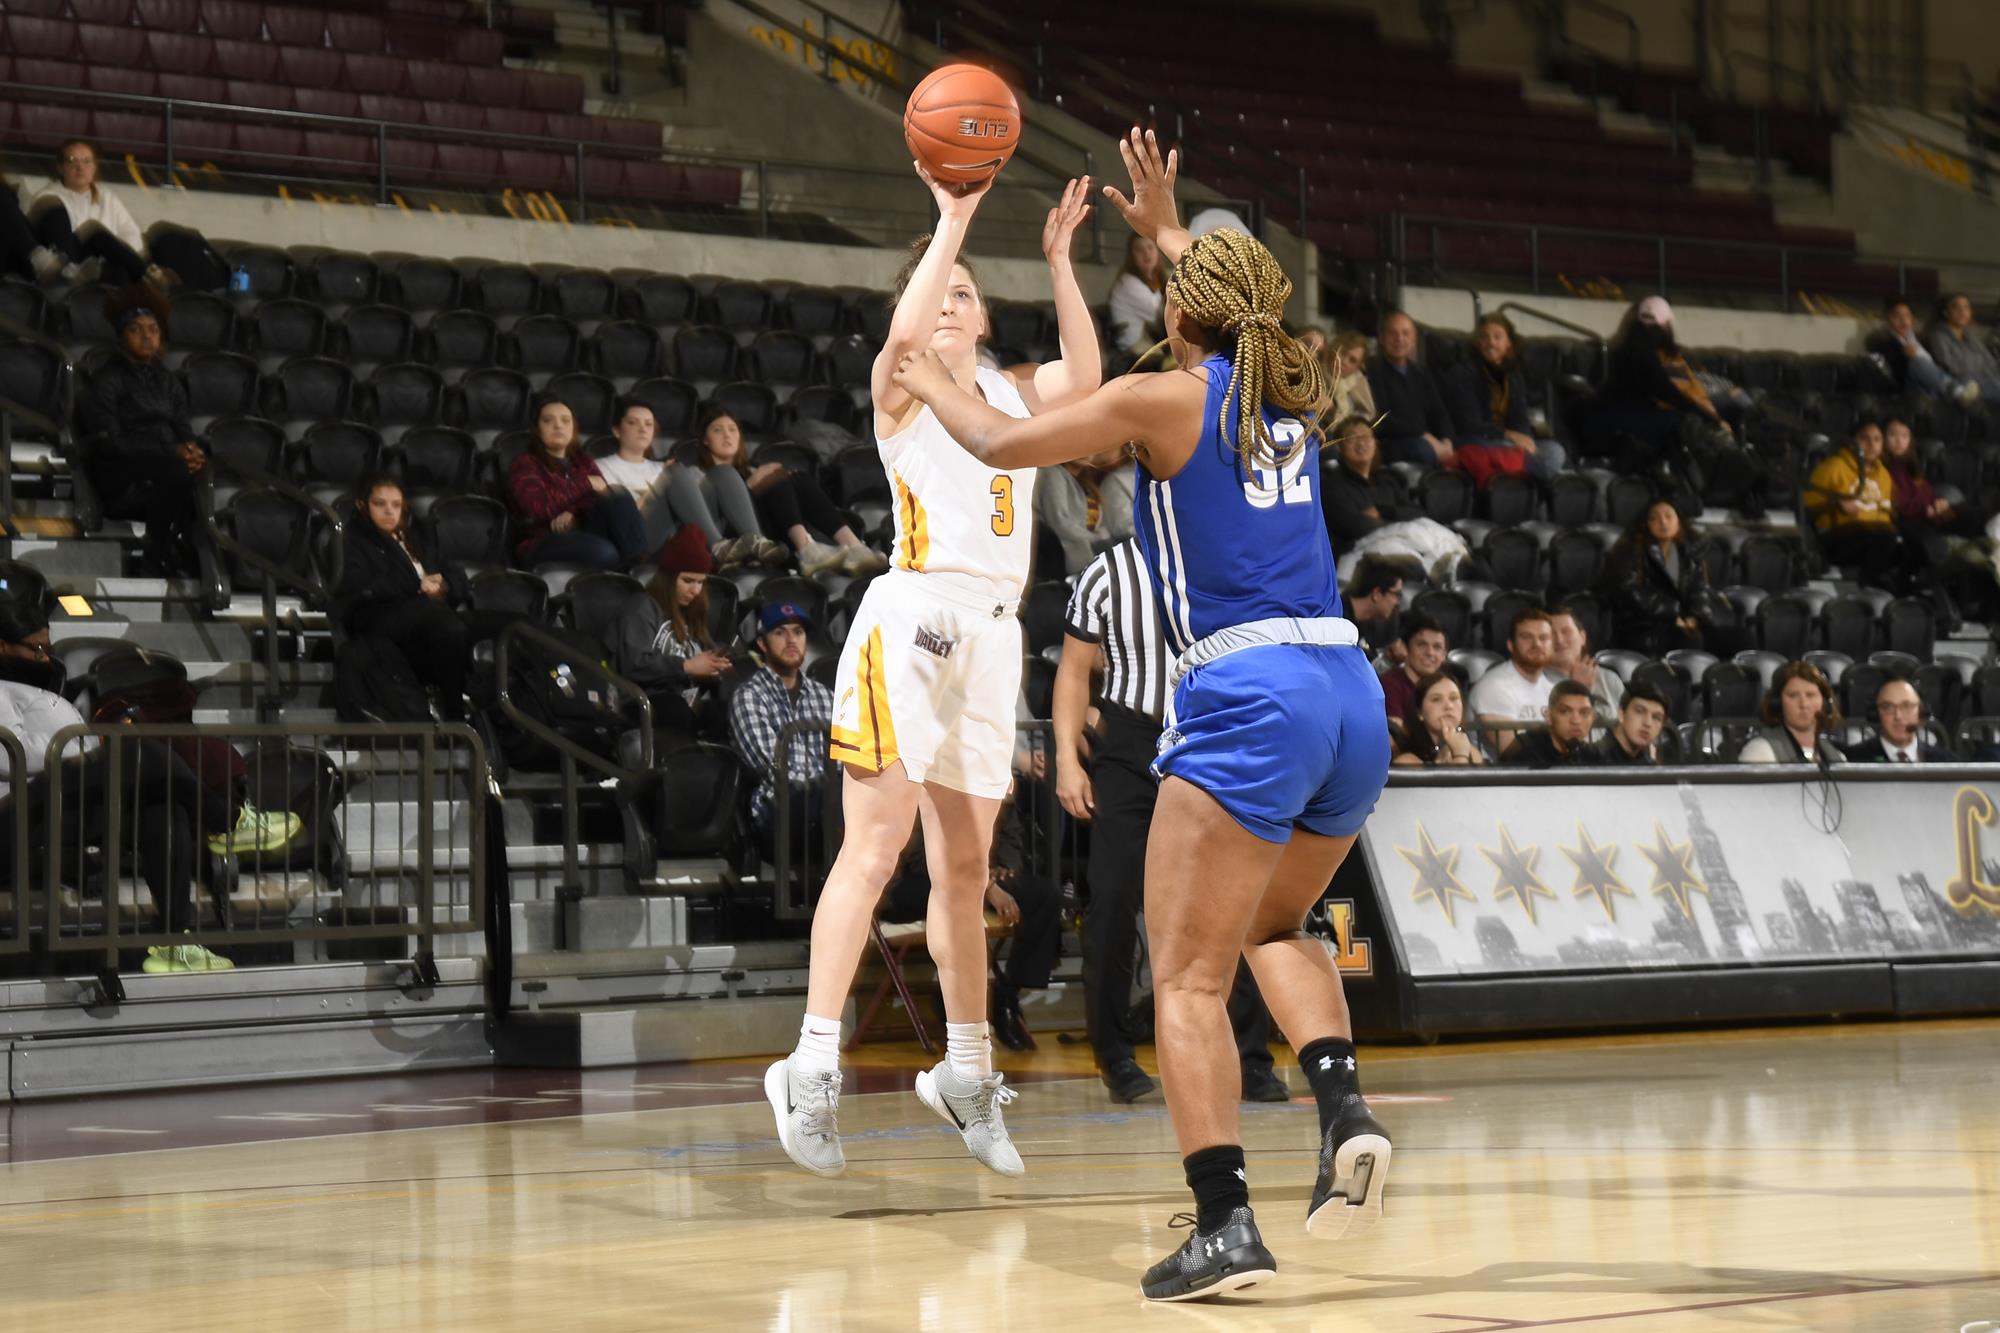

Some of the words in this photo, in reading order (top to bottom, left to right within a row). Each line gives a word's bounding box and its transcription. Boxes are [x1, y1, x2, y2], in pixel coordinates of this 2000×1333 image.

[958, 118, 1008, 138] ELITE
[990, 474, 1014, 536] 3
[914, 624, 956, 659] VALLEY
